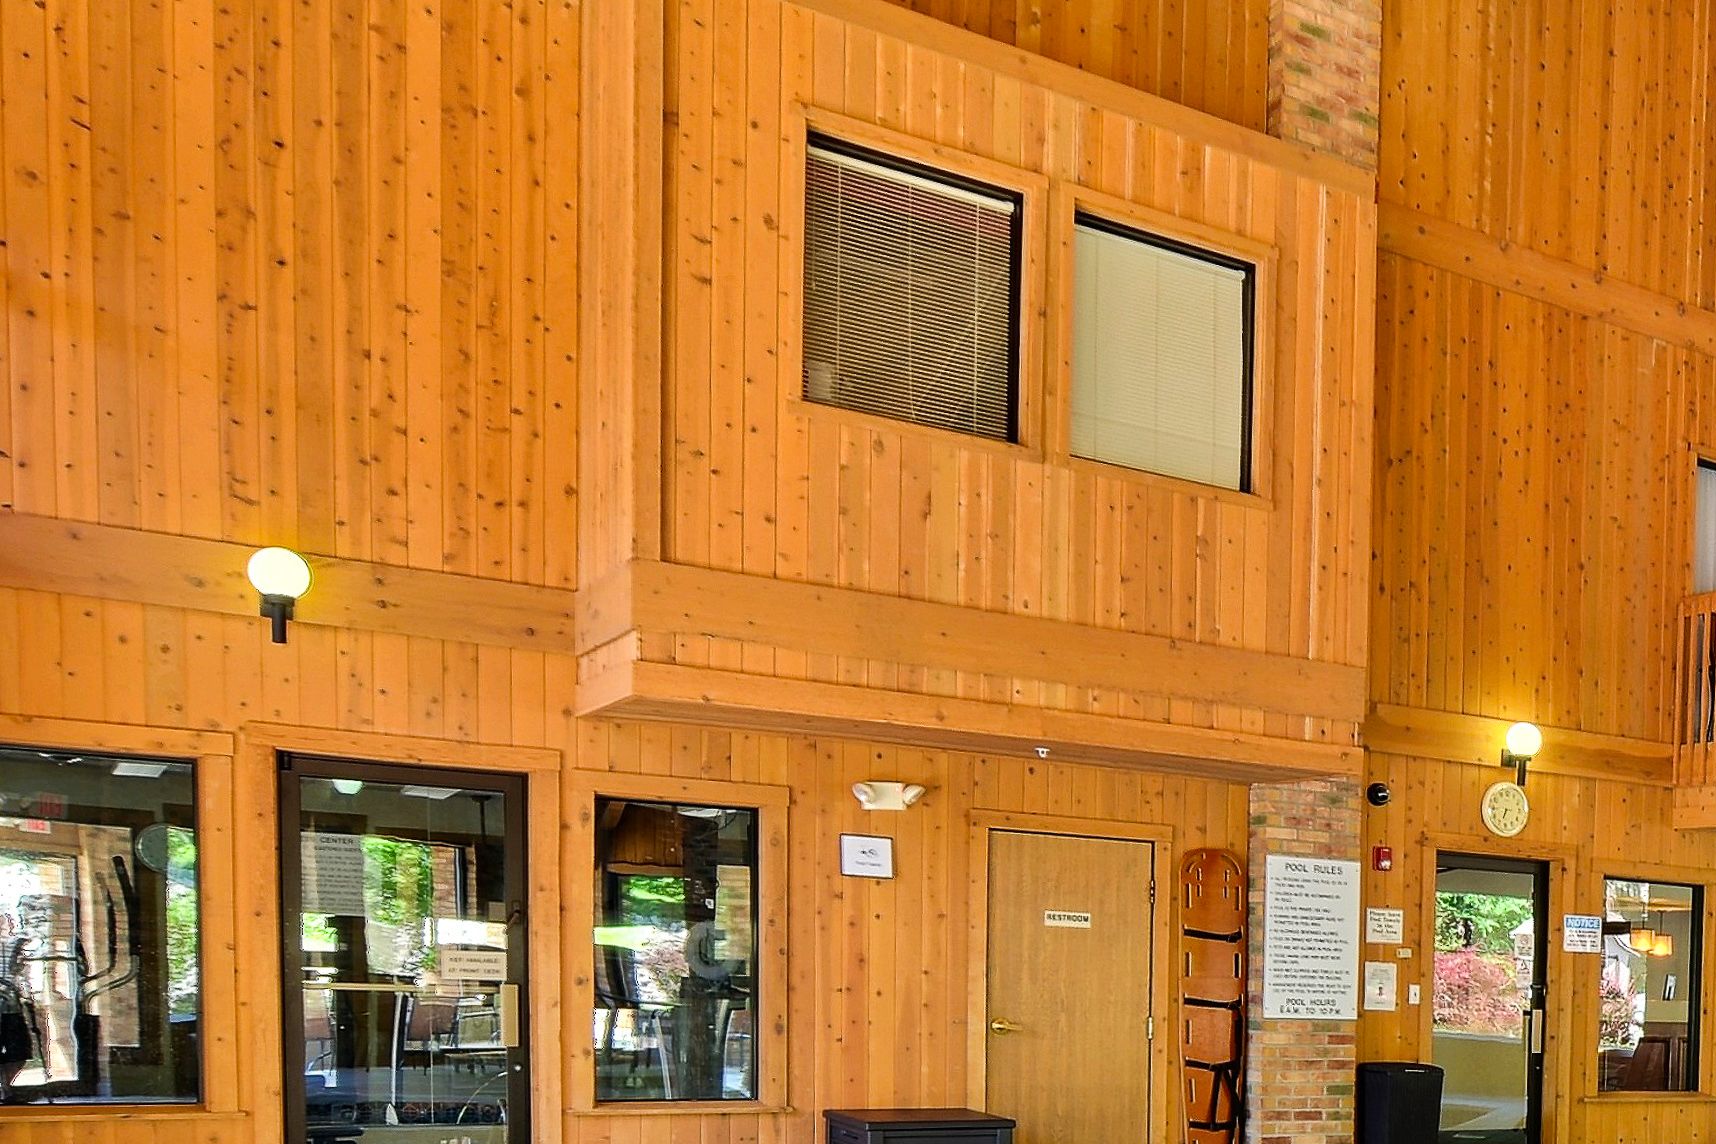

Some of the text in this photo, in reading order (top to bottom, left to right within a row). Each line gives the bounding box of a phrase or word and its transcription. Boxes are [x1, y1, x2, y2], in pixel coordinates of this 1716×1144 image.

[1285, 862, 1343, 875] POOL RULES
[1046, 913, 1089, 923] RESTROOM
[1566, 917, 1600, 928] NOTICE
[1286, 998, 1306, 1006] POOL
